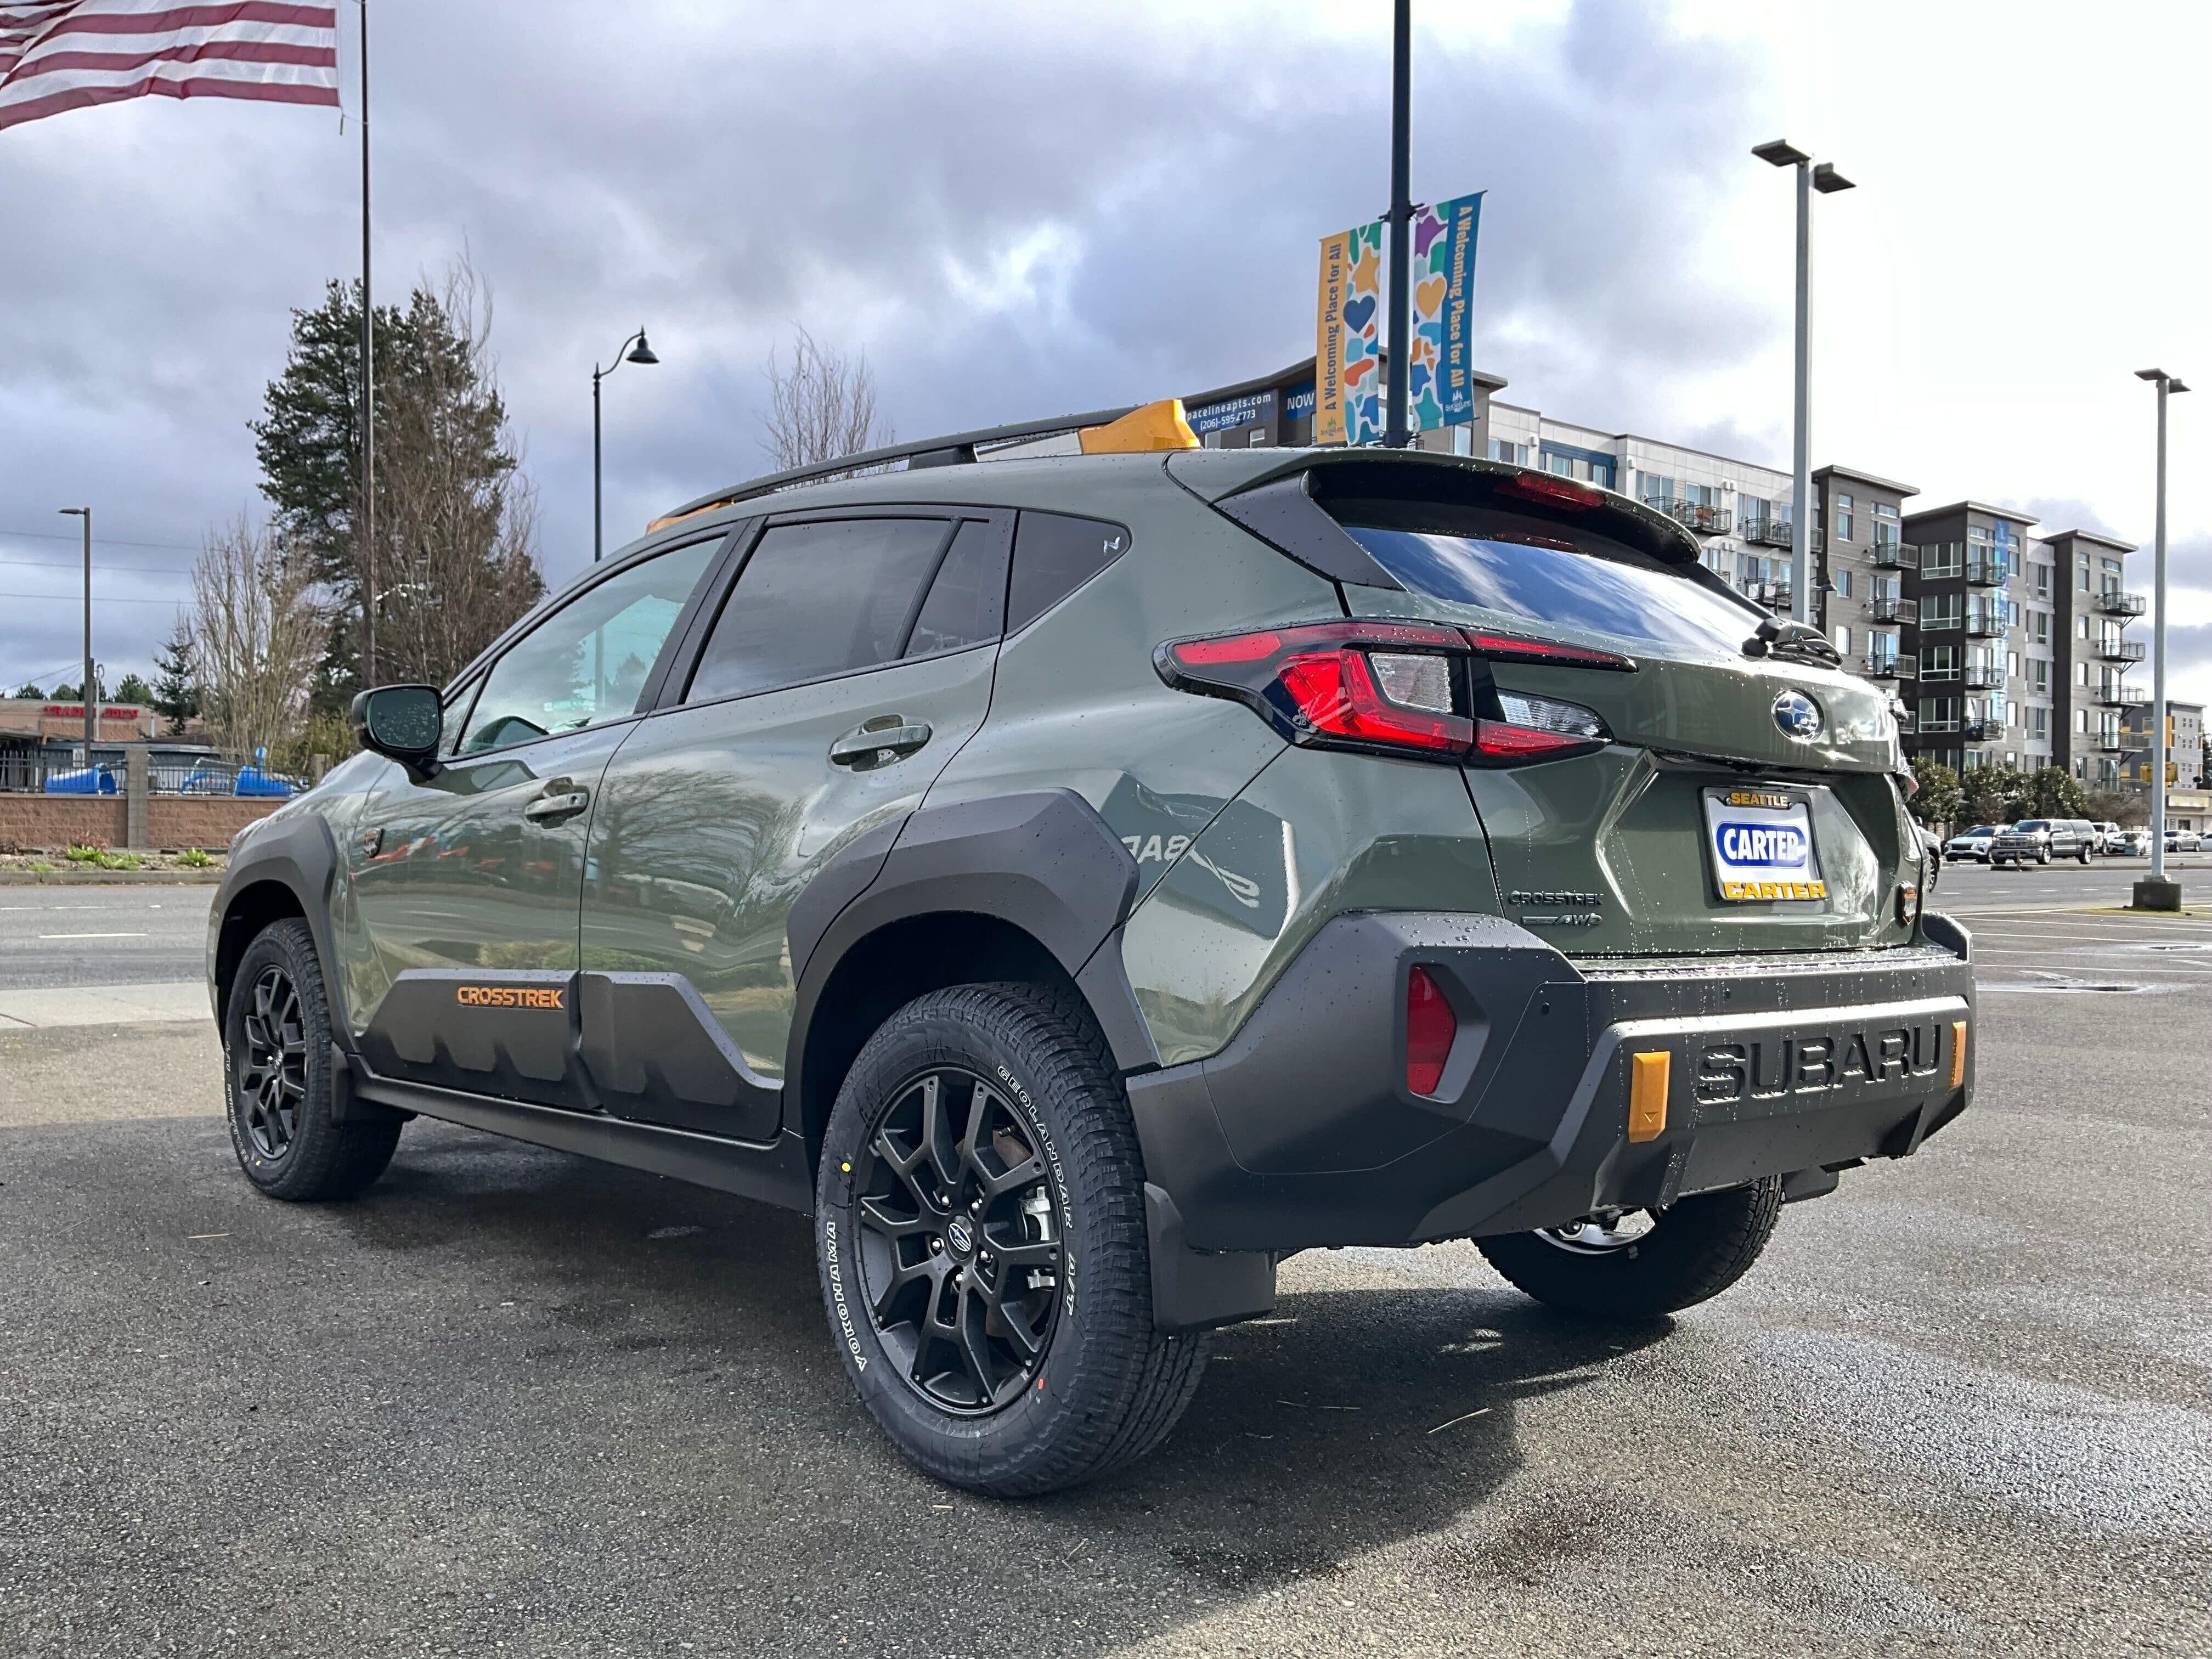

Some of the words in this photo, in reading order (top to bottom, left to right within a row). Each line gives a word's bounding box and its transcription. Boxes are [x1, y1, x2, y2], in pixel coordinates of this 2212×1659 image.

[1459, 206, 1473, 216] A
[1329, 243, 1341, 260] All
[1449, 216, 1472, 298] Welcoming
[1328, 264, 1340, 283] for
[1325, 286, 1339, 322] Place
[1450, 300, 1465, 340] Place
[1324, 324, 1340, 400] Welcoming
[1450, 342, 1464, 364] for
[1451, 369, 1464, 387] All
[1287, 392, 1315, 411] NOW
[1325, 401, 1337, 410] A
[1730, 792, 1788, 808] SEATTLE
[1723, 828, 1799, 861] CARTER
[1510, 890, 1604, 905] CROSSTREK
[1723, 881, 1827, 899] CARTER
[1554, 913, 1603, 926] AWD
[457, 986, 565, 1009] CROSSTREK
[1697, 1024, 1942, 1104] SUBARU
[997, 1065, 1073, 1229] GEOLANDAR
[1065, 1251, 1077, 1316] A/T
[826, 1221, 867, 1372] YOKOHAMA
